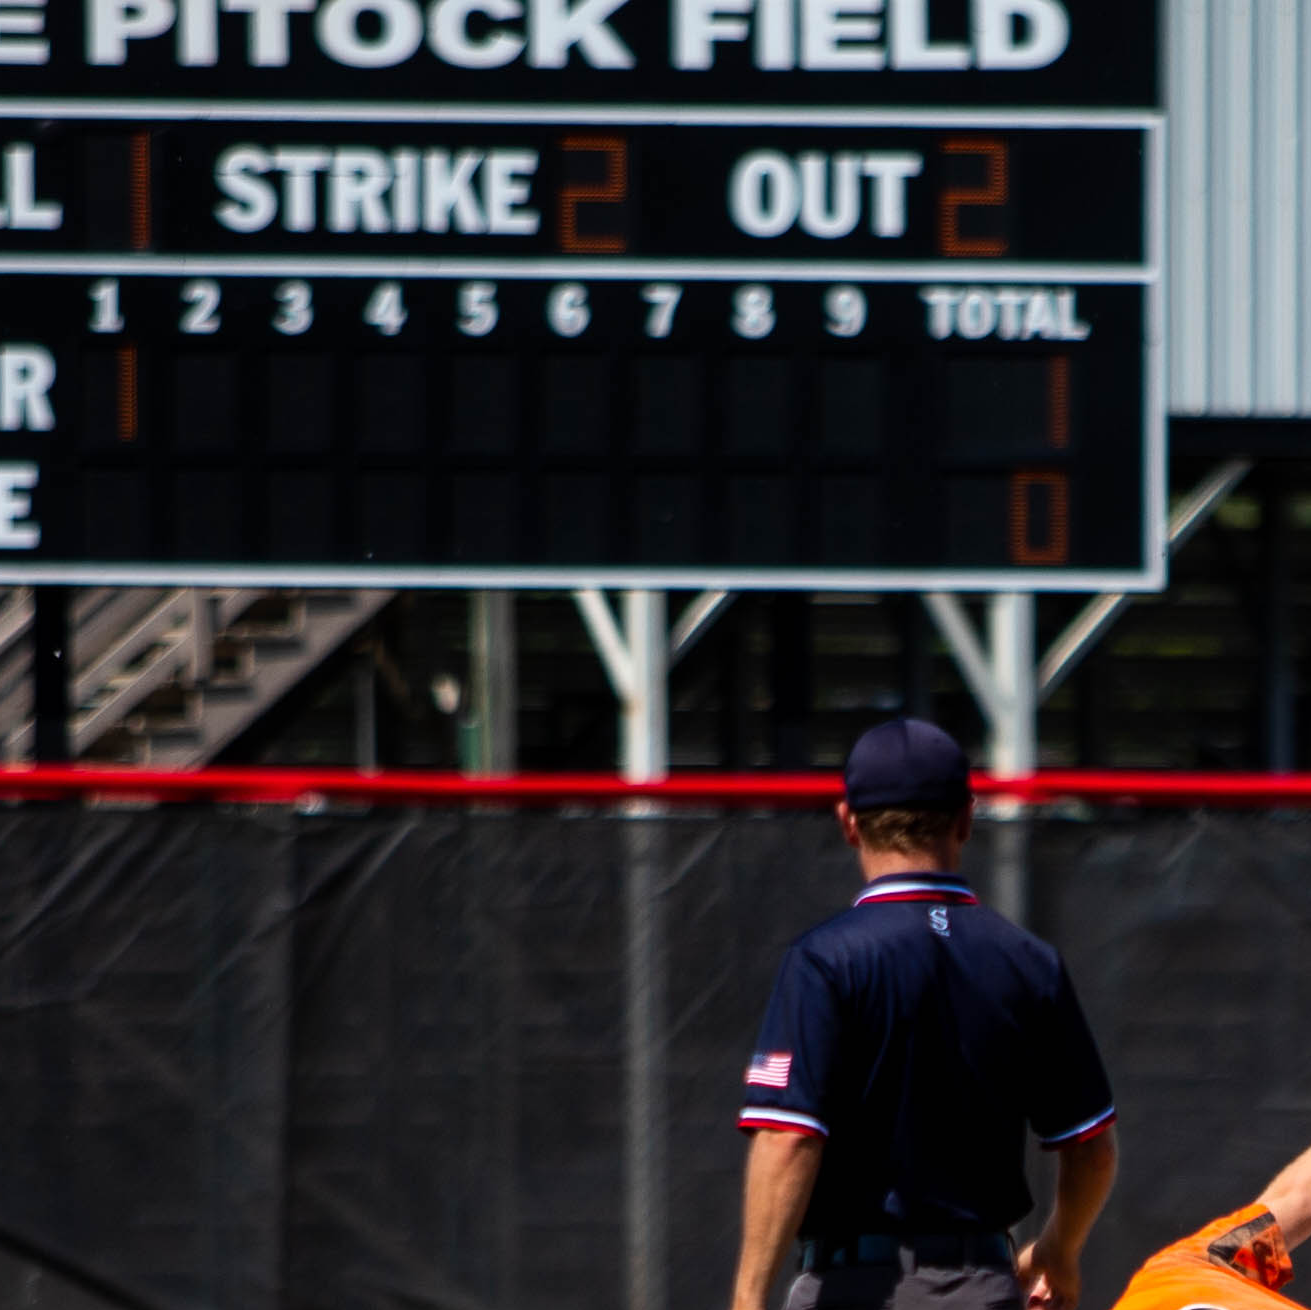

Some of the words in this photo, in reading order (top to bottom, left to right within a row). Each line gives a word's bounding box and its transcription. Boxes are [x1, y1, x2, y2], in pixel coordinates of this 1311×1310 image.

[87, 0, 636, 70] PITOCK
[670, 0, 1071, 71] FIELD
[131, 130, 151, 250] 1
[214, 144, 540, 235] STRIKE
[559, 137, 627, 253] 2
[729, 149, 922, 239] OUT
[939, 139, 1008, 256] 2
[91, 280, 124, 332] 1
[180, 280, 222, 334] 2
[272, 281, 314, 335] 3
[364, 281, 407, 336] 4
[456, 282, 498, 336] 5
[547, 282, 590, 337] 6
[641, 284, 682, 338] 7
[731, 284, 775, 339] 8
[824, 284, 867, 339] 9
[920, 286, 1089, 341] TOTAL
[1010, 469, 1069, 566] 0
